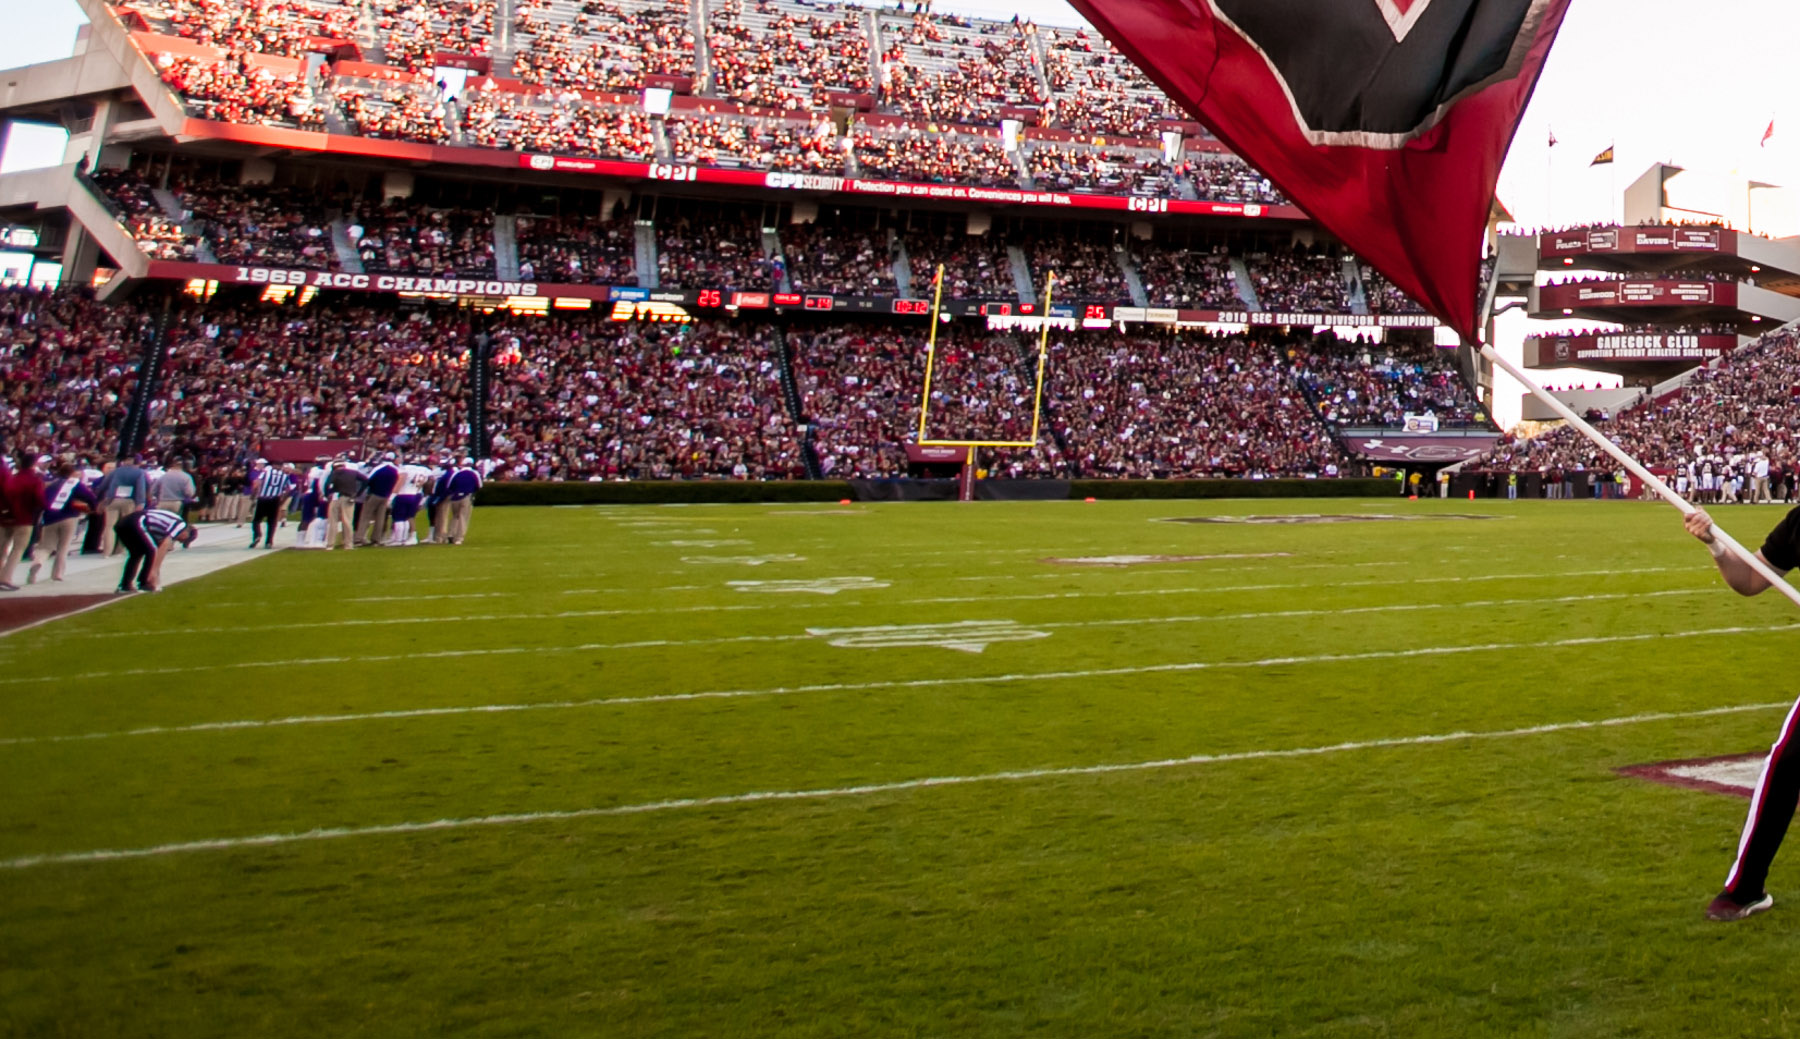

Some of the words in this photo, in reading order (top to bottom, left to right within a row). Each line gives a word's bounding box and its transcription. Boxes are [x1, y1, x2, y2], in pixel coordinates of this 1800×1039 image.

[649, 163, 697, 181] CPI
[765, 172, 803, 189] CPI
[803, 174, 845, 191] SECURITY
[852, 179, 894, 193] Protection
[895, 183, 911, 196] you
[912, 185, 928, 195] can
[929, 185, 953, 197] count
[953, 187, 967, 198] on.
[968, 187, 1022, 202] Conveniences
[1022, 192, 1038, 204] you
[1038, 192, 1052, 203] will
[1053, 193, 1072, 205] love.
[1128, 196, 1168, 212] CPI
[236, 266, 307, 283] 1969
[313, 272, 370, 288] ACC
[377, 275, 538, 296] CHAMPIONS
[699, 290, 721, 307] 25
[1086, 305, 1106, 319] 25
[1218, 311, 1248, 323] 2010
[1251, 312, 1272, 324] SEC
[1276, 313, 1323, 325] EASTERN
[1325, 314, 1375, 326] DIVISION
[1597, 335, 1662, 349] GAMECOCK
[1666, 335, 1699, 348] CLUB
[1615, 348, 1646, 358] STUDENT
[1647, 348, 1681, 357] ATHLETES
[1682, 348, 1703, 357] SINCE
